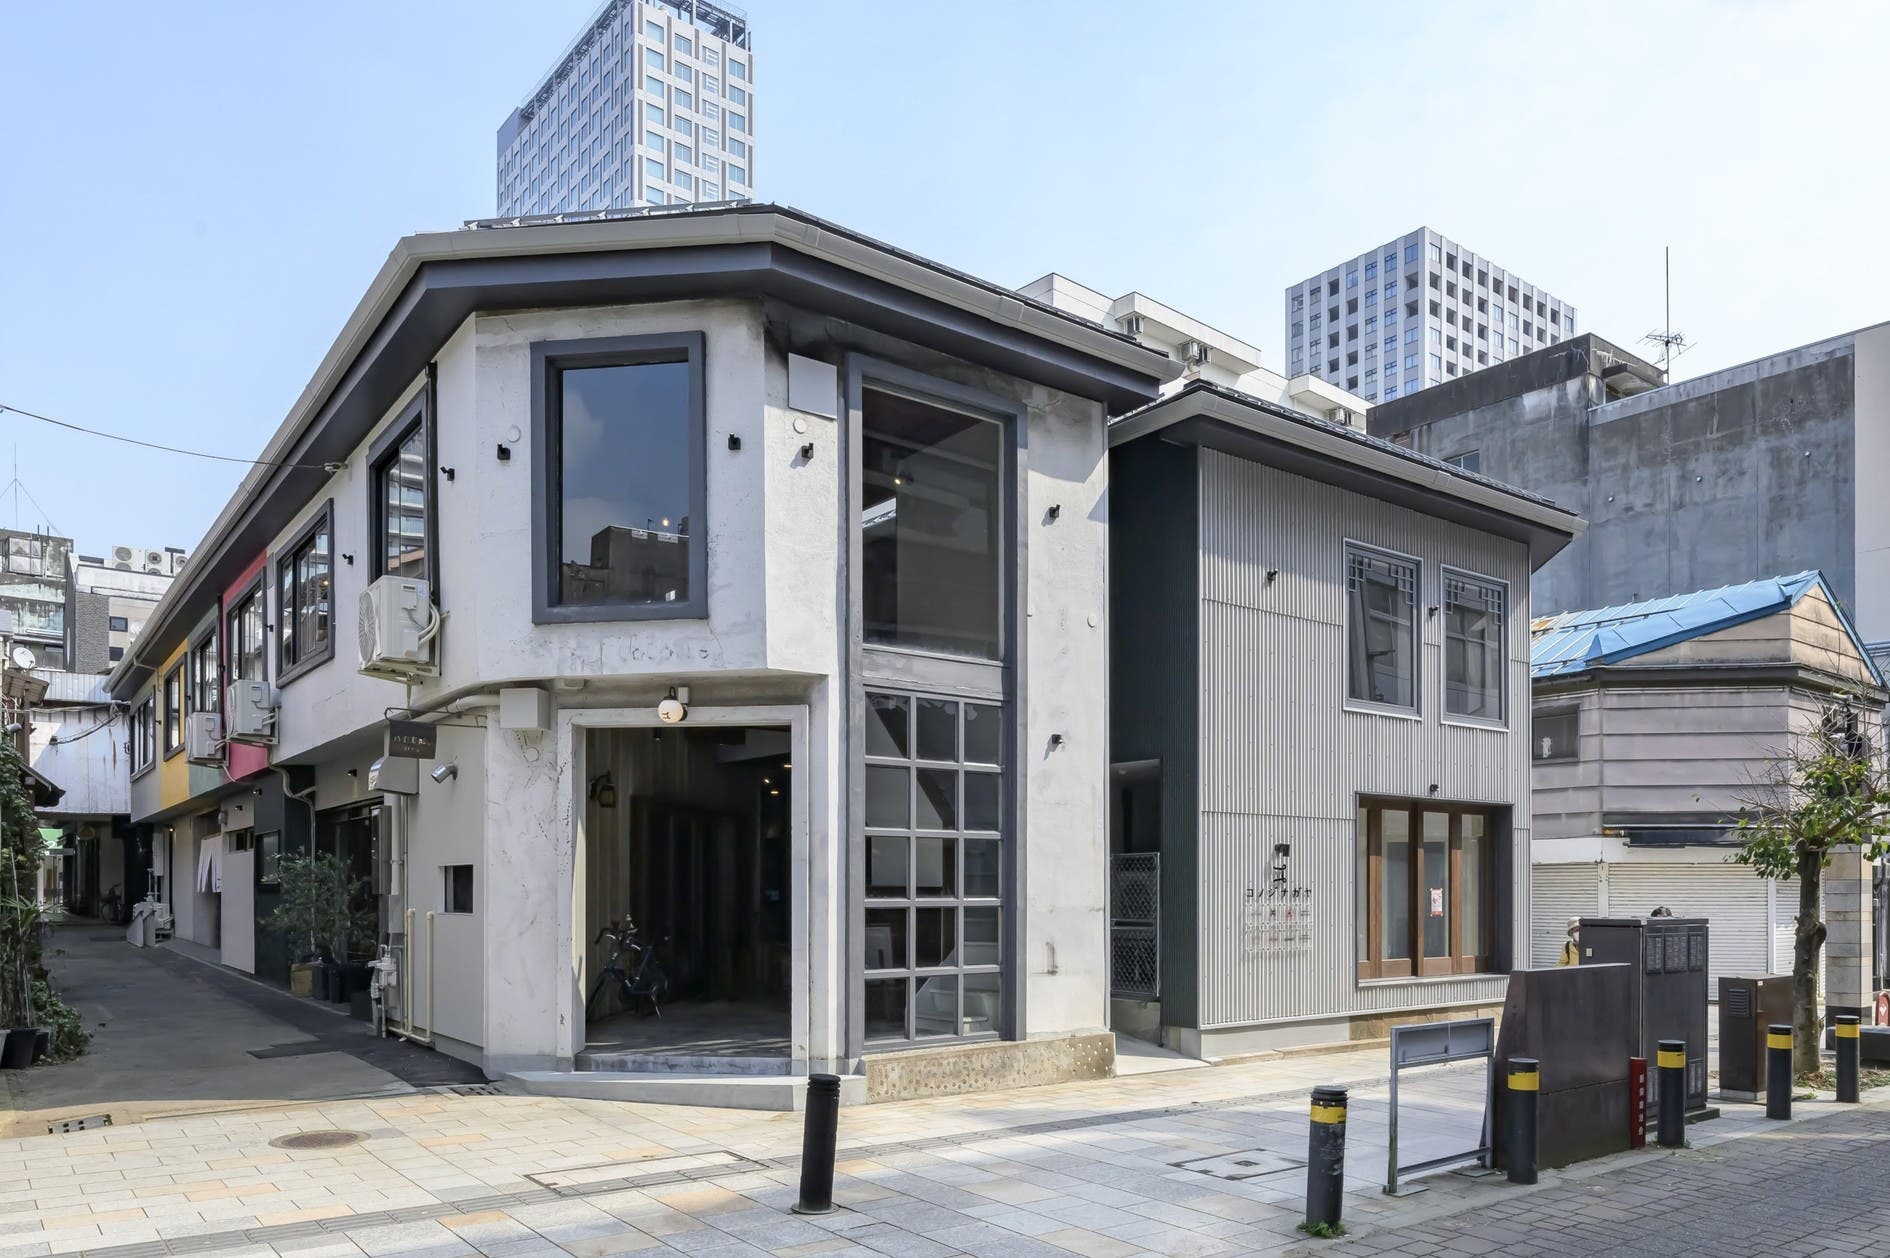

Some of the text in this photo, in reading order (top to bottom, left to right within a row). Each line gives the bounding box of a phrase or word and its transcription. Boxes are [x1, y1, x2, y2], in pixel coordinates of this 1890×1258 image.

[1246, 887, 1312, 898] コノジナガヤ
